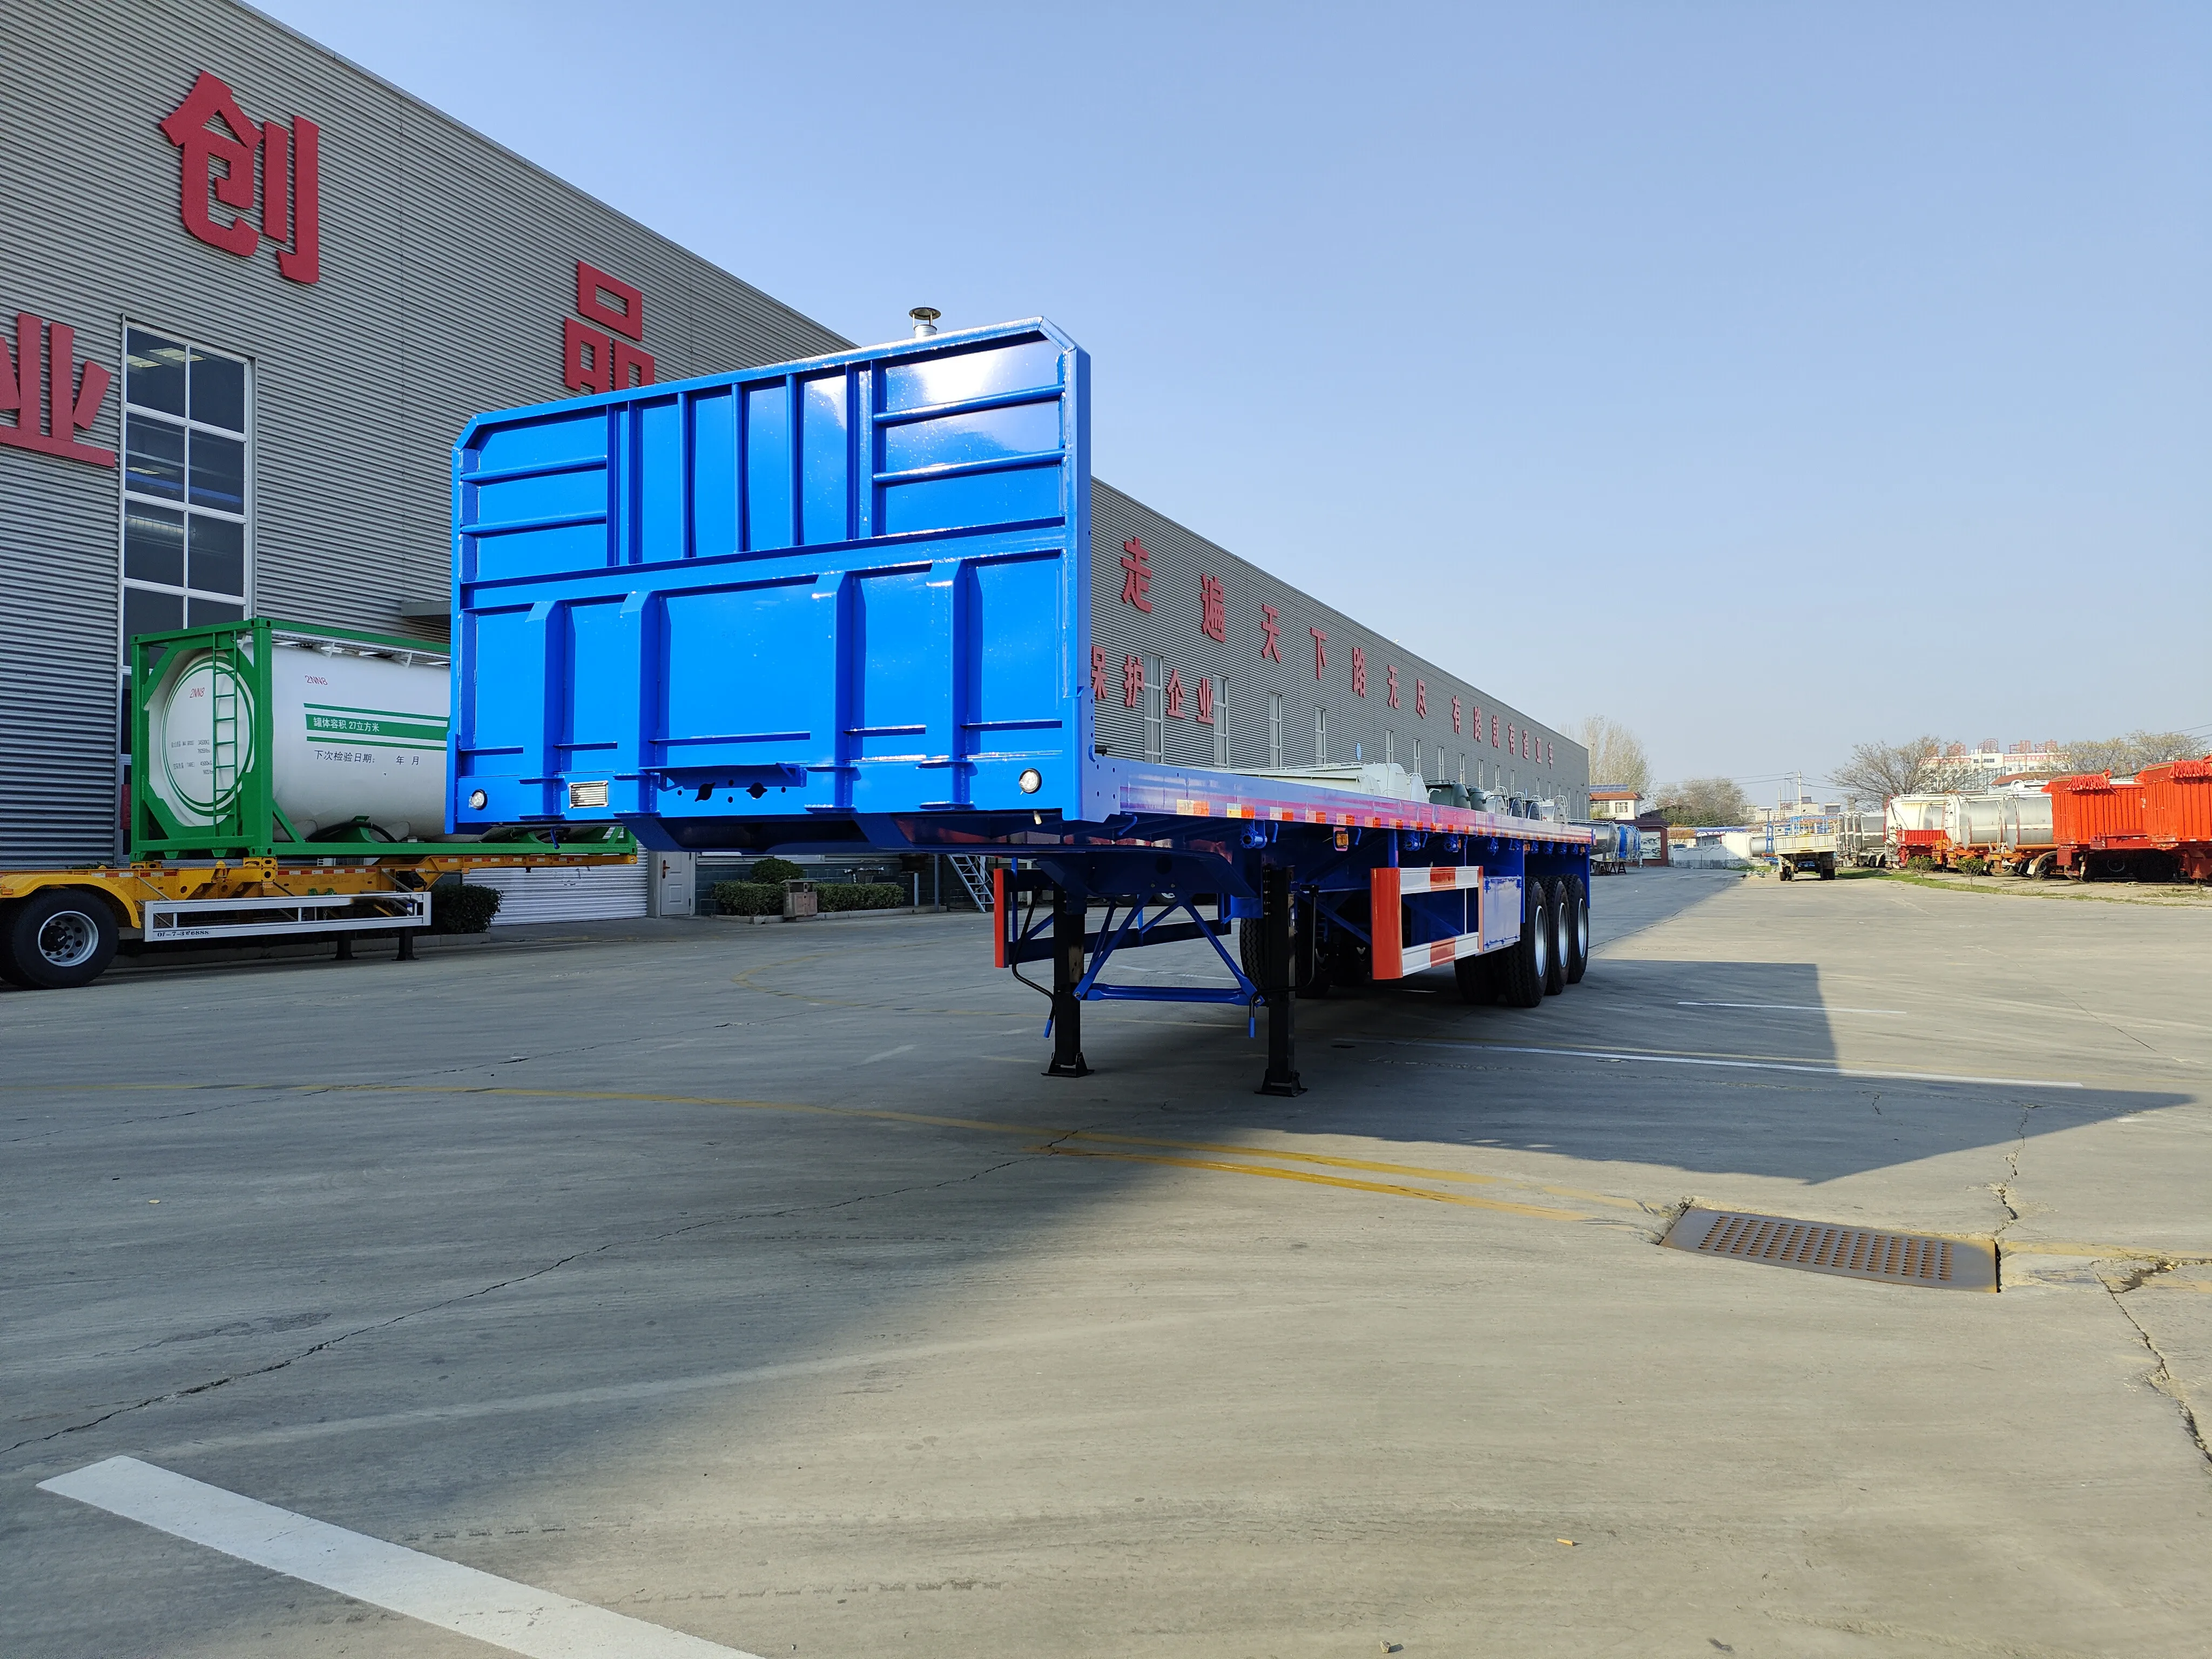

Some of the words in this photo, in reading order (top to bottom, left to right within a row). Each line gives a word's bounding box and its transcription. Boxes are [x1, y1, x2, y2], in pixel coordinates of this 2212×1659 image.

[305, 675, 328, 685] 2NN8
[190, 687, 205, 698] 2NN8
[313, 717, 347, 730] 罐体容积
[349, 721, 379, 732] 27立方米
[396, 755, 404, 765] 年
[412, 756, 420, 766] 月
